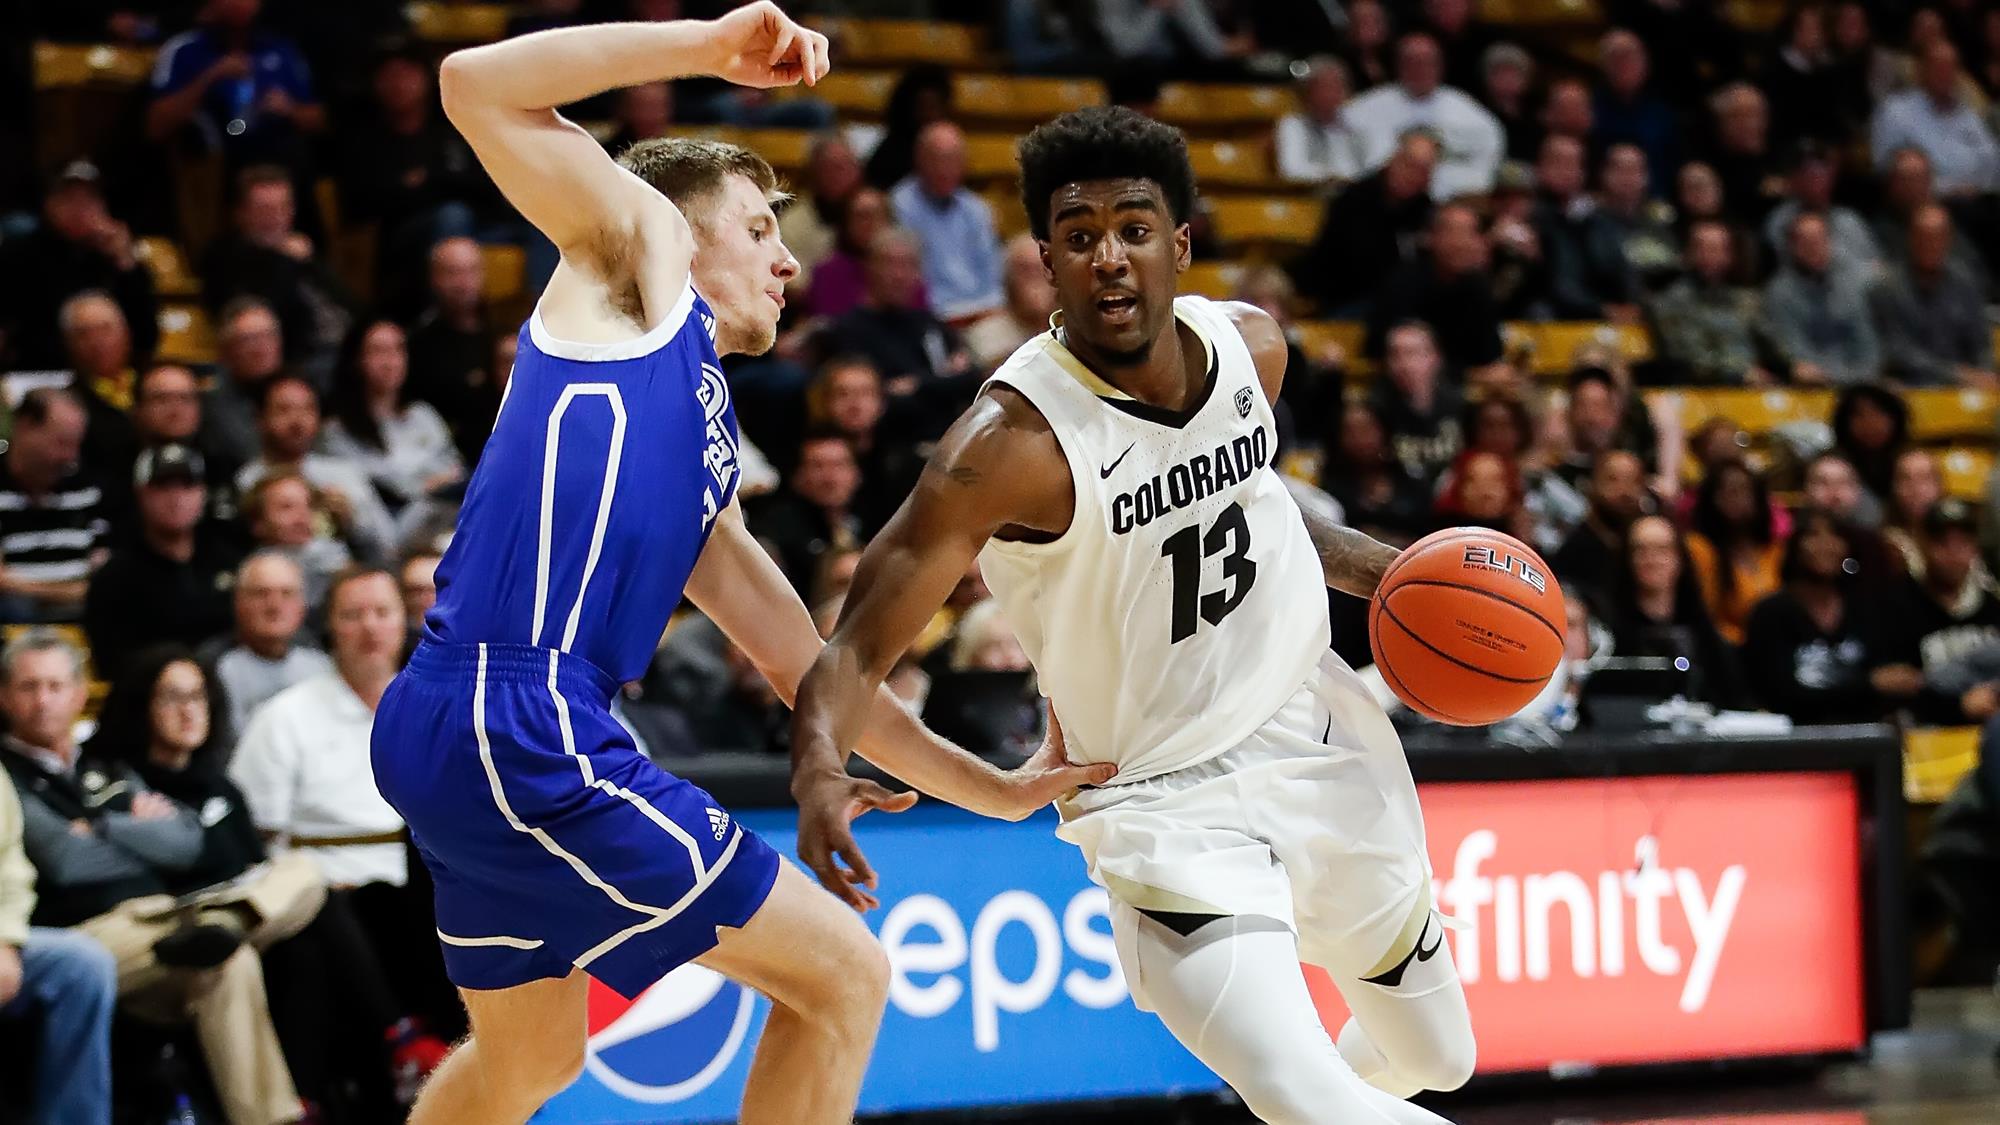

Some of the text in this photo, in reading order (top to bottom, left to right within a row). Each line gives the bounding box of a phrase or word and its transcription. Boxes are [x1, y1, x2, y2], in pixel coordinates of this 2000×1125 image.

[1112, 424, 1267, 535] COLORADO
[1161, 501, 1257, 645] 13
[1464, 545, 1546, 593] ELITE
[880, 886, 1129, 1053] eps
[1431, 828, 1747, 1014] finity
